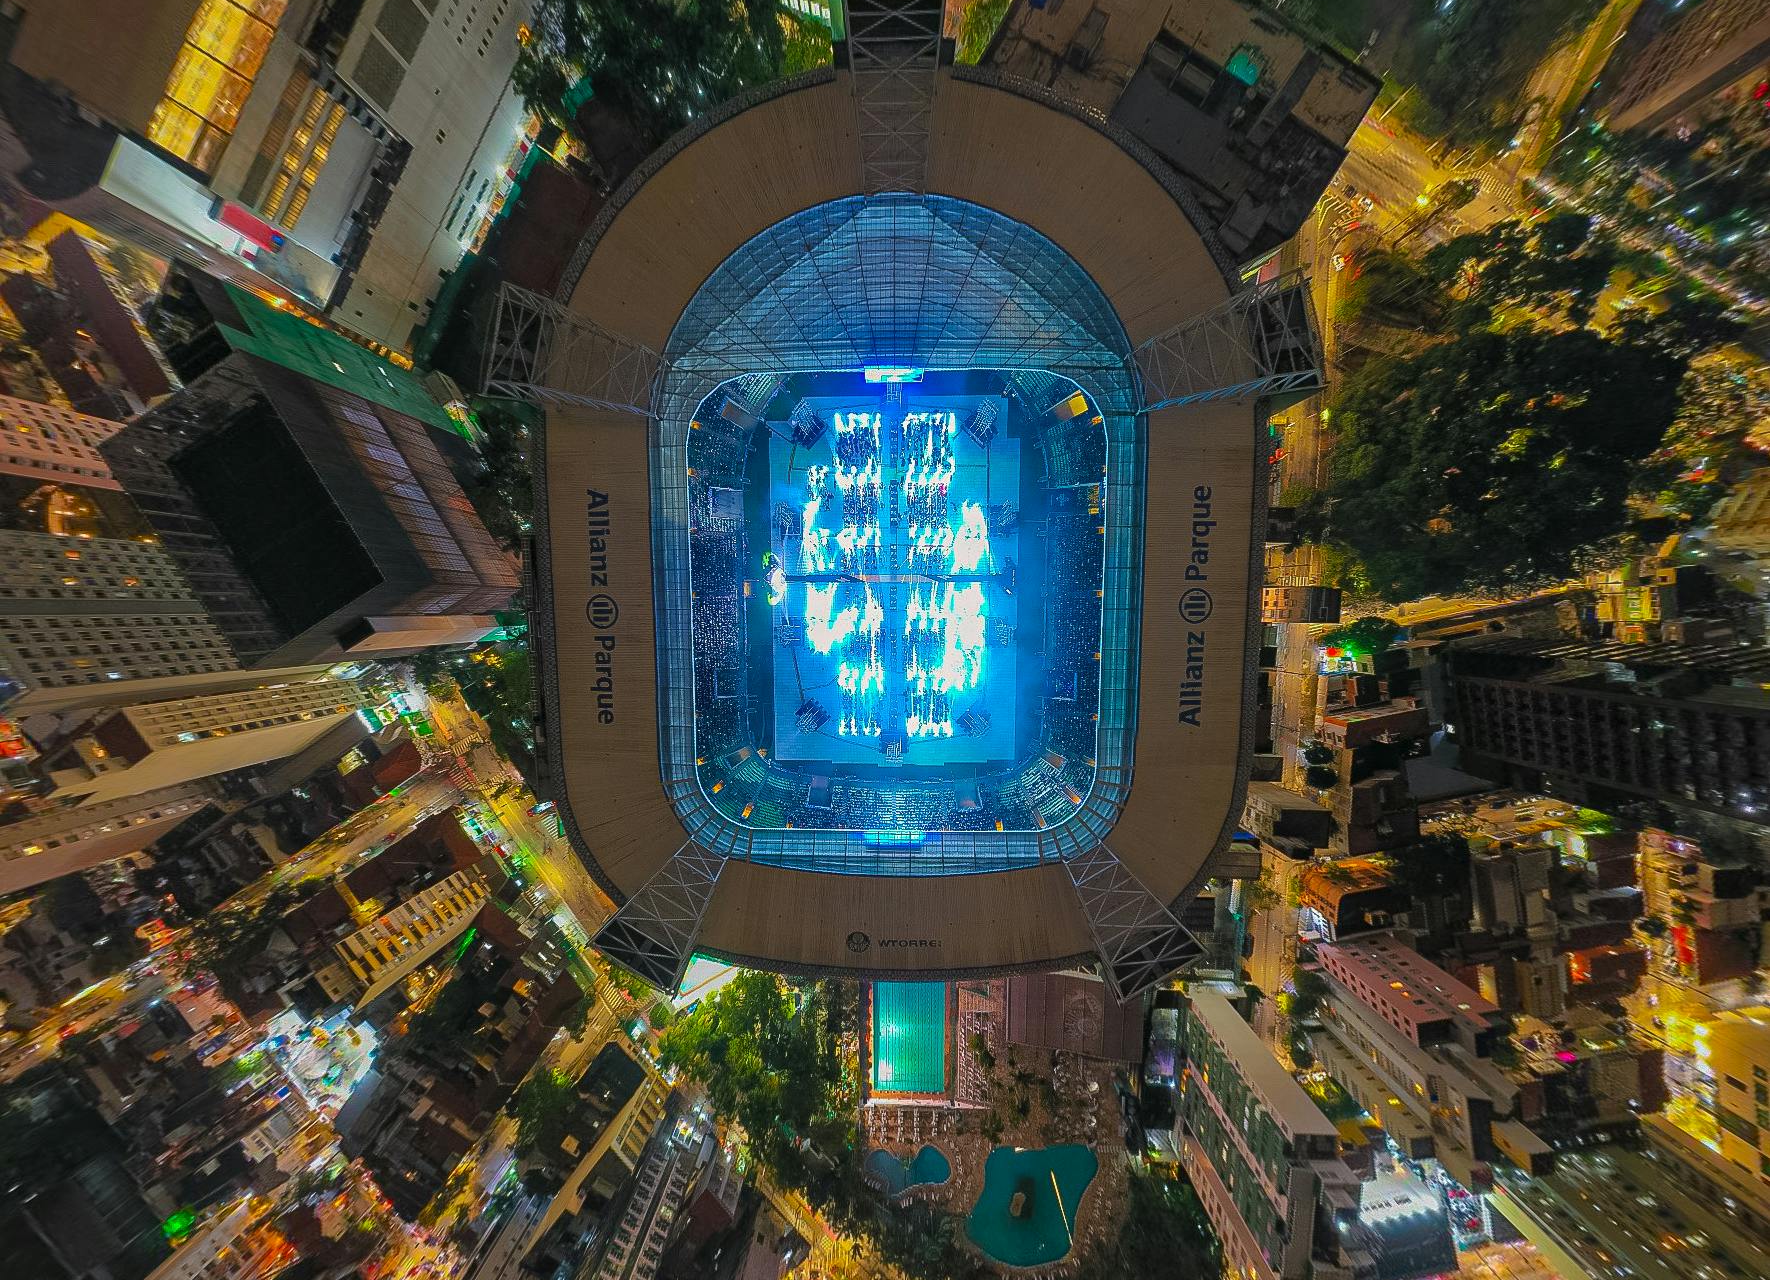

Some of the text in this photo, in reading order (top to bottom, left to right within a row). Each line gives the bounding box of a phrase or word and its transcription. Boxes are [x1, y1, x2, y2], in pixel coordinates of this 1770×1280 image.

[587, 488, 616, 725] Allianz Parque
[1178, 485, 1217, 728] Allianz Parque
